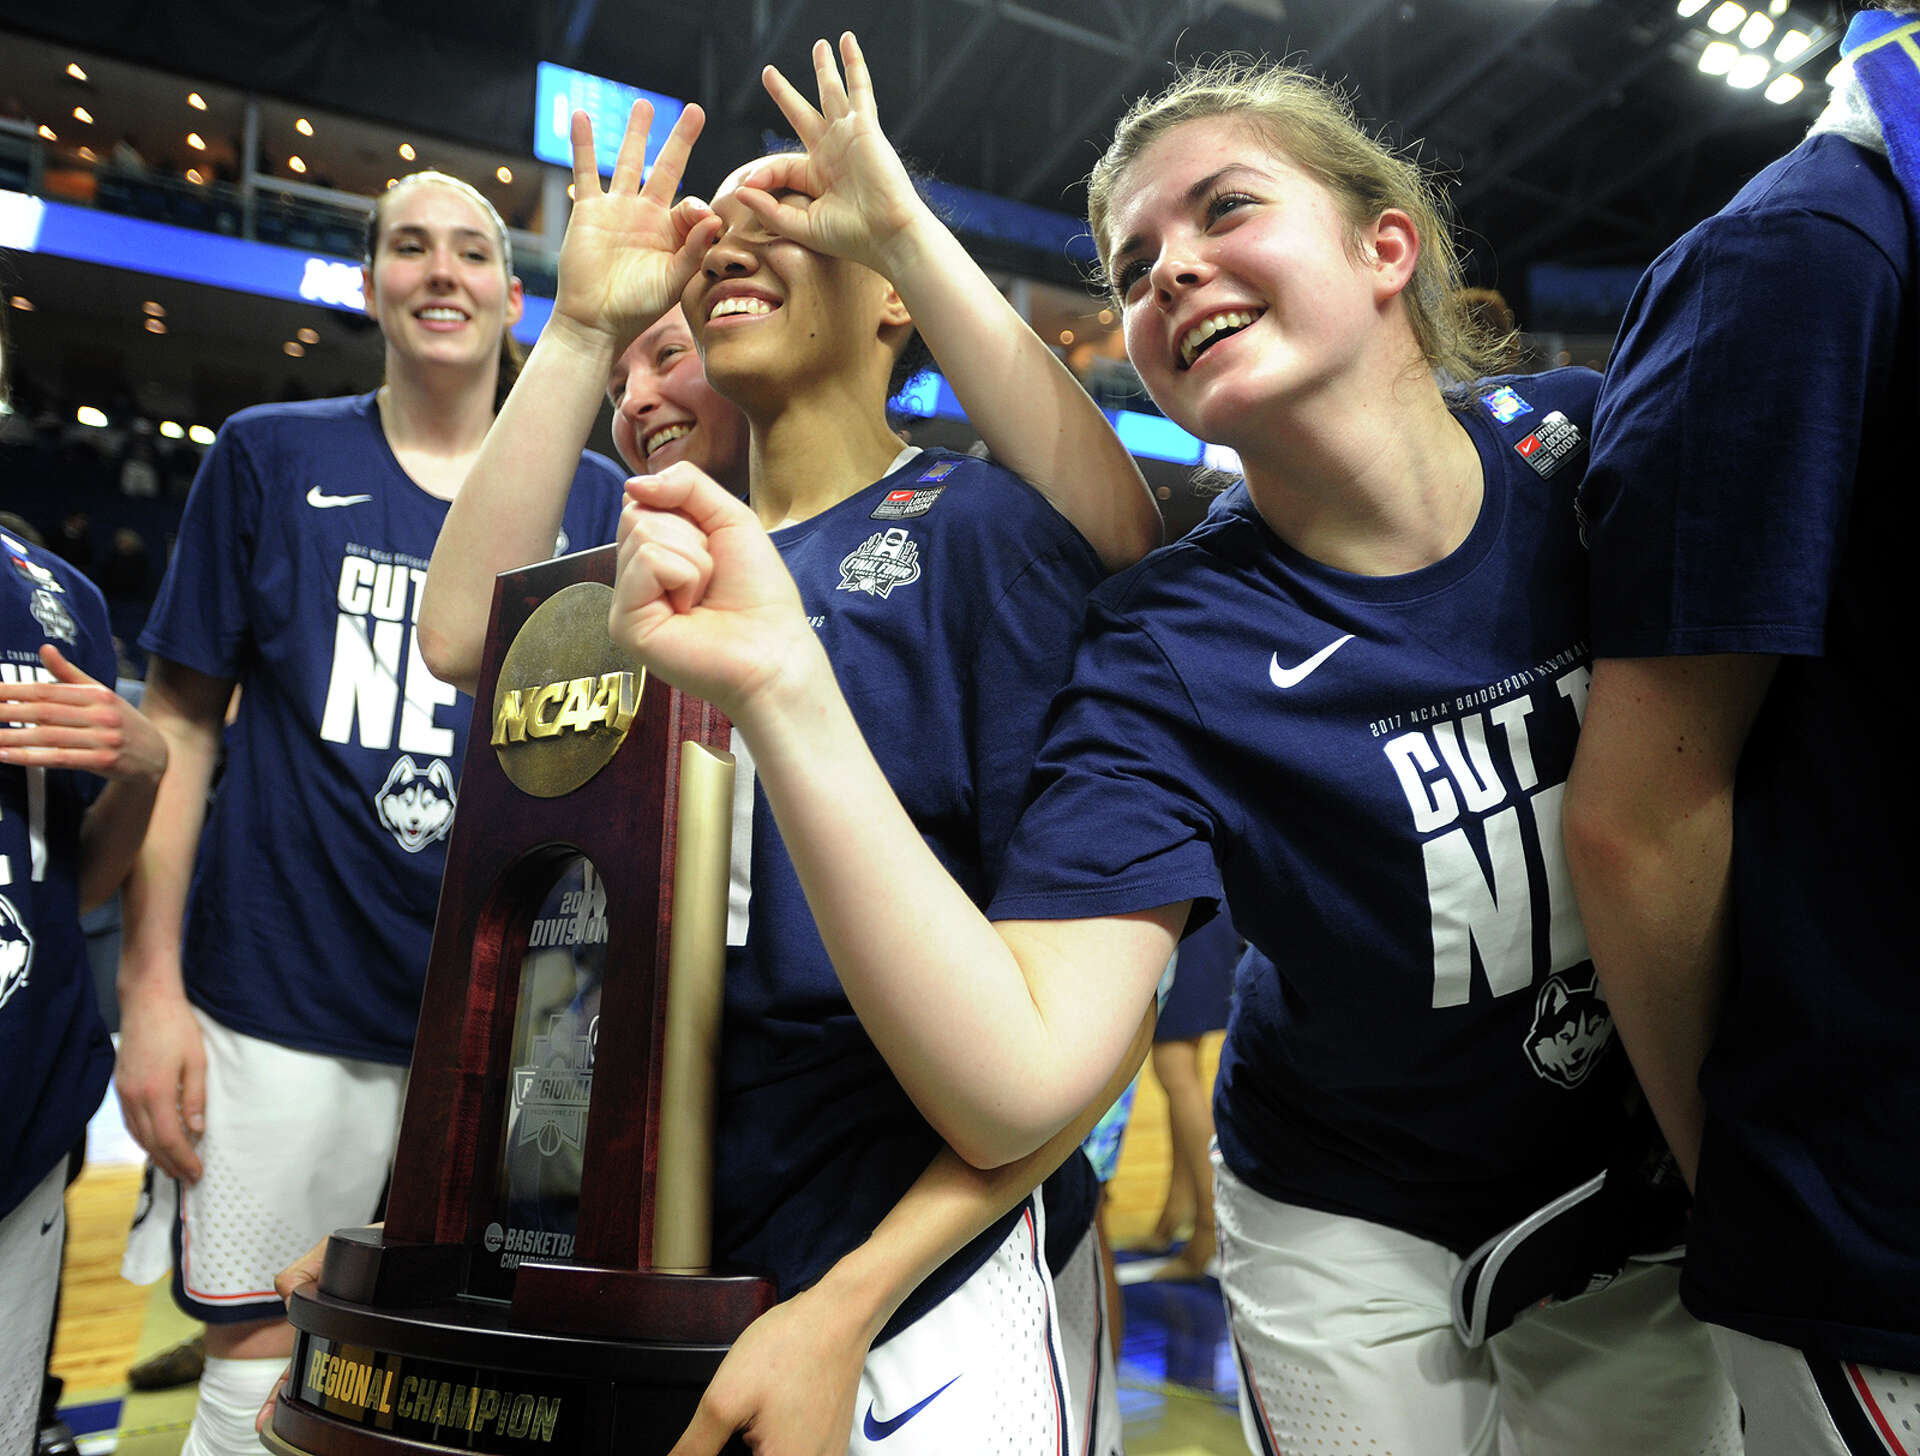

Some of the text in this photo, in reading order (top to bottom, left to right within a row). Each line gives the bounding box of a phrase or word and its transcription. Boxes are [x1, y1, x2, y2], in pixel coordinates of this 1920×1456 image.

[1542, 423, 1573, 450] LOCKER
[1551, 432, 1581, 459] ROOM
[845, 557, 880, 573] FINAL
[877, 562, 913, 579] FOUR
[490, 671, 635, 747] NCAA
[1369, 714, 1402, 738] 2017
[1410, 702, 1449, 723] NCAA
[1456, 669, 1536, 711] BRIDGEPORT
[1383, 694, 1539, 833] CUT
[528, 916, 609, 947] DIVISION
[307, 1349, 562, 1443] REGIONAL CHAMPION
